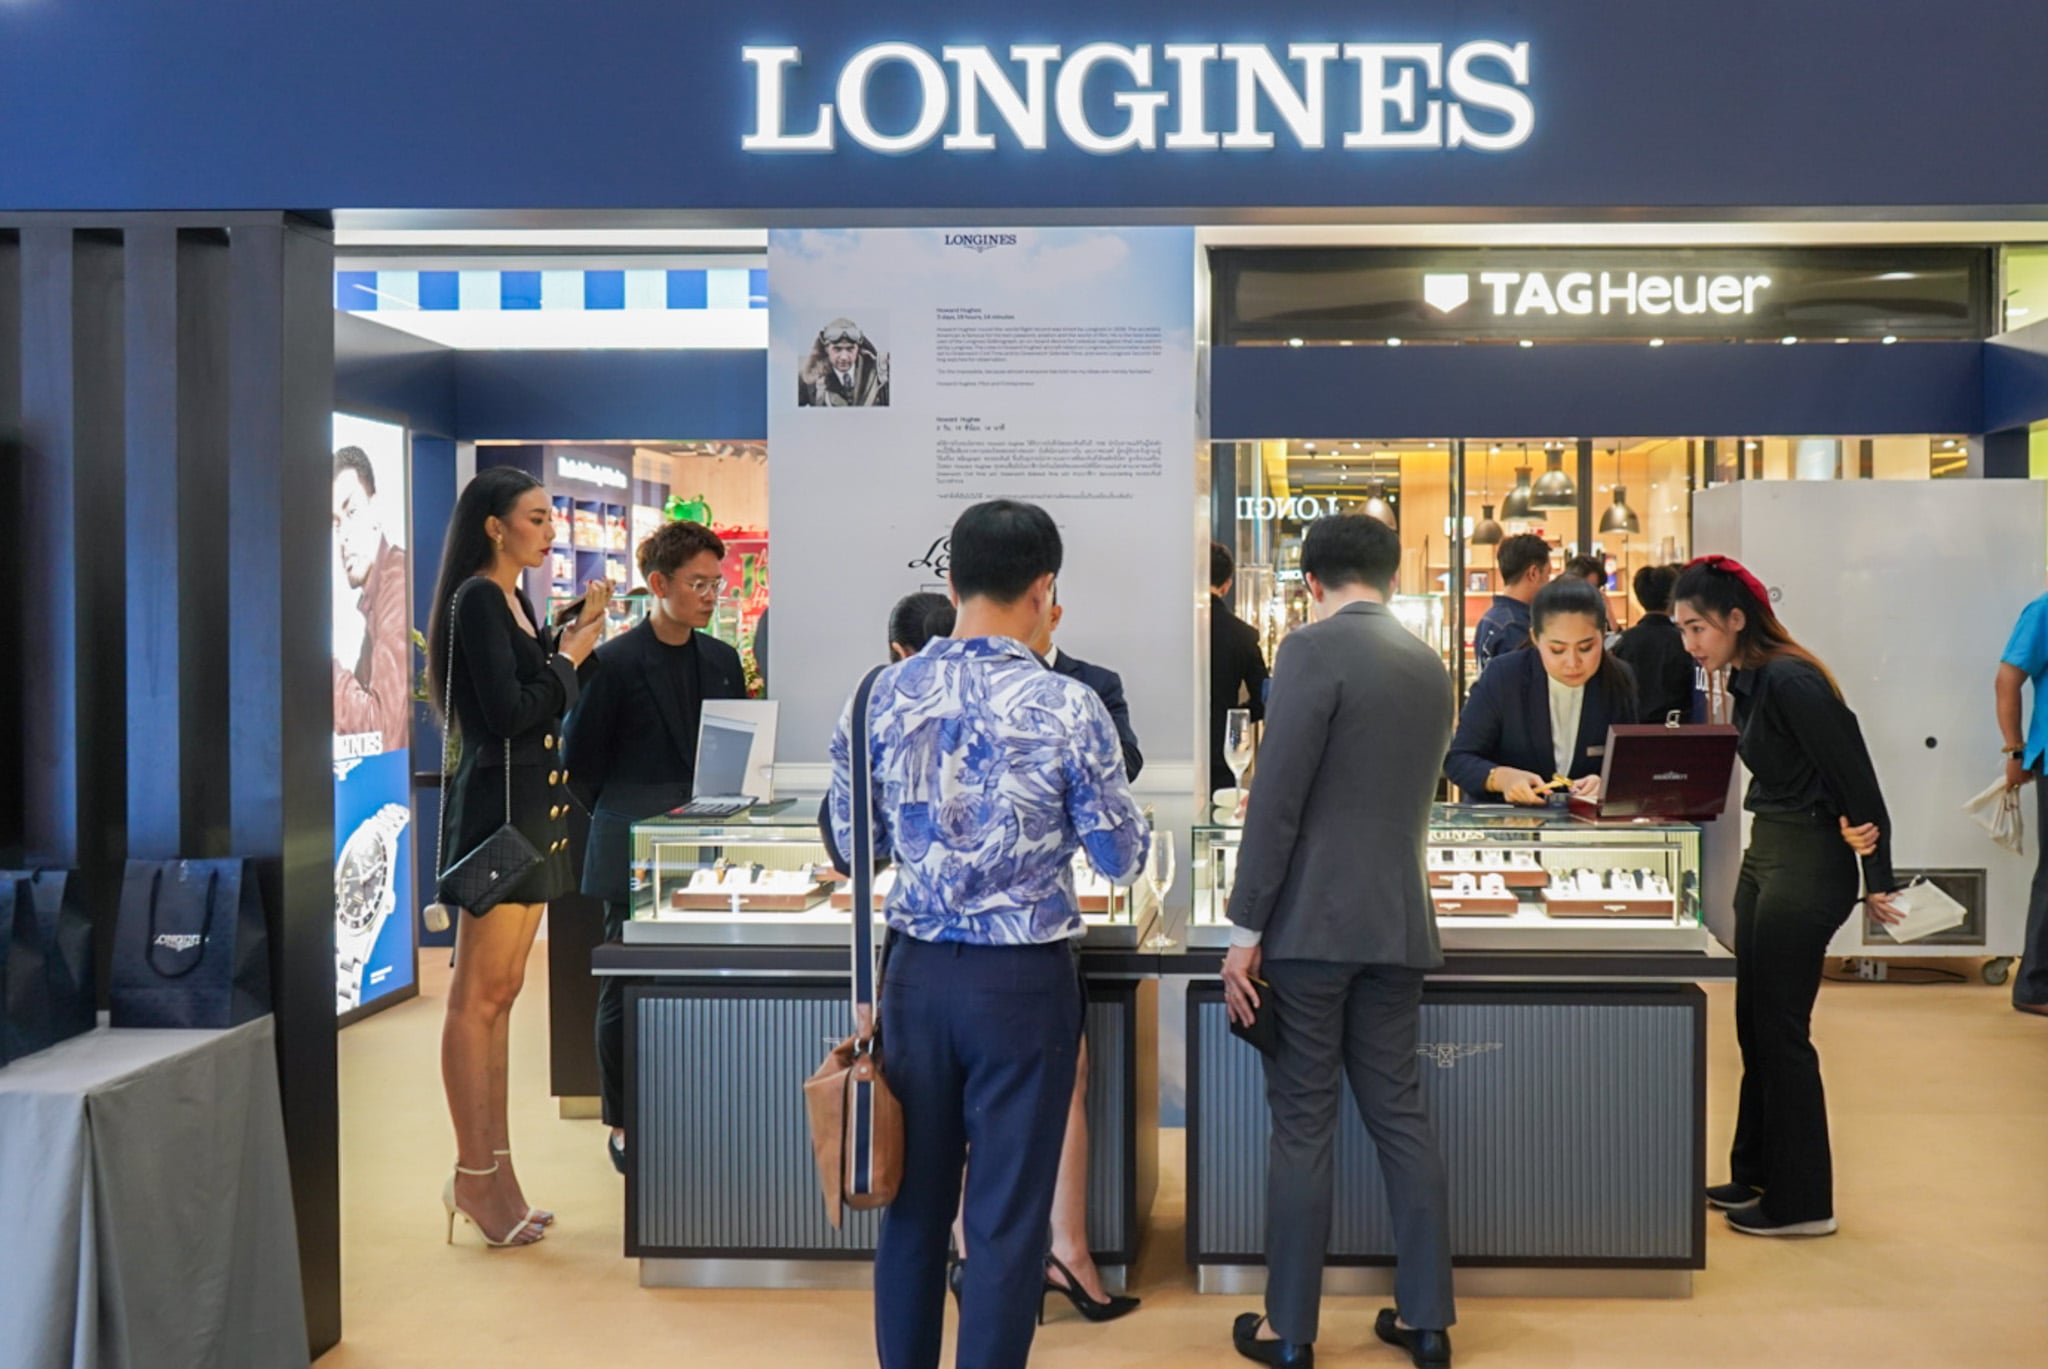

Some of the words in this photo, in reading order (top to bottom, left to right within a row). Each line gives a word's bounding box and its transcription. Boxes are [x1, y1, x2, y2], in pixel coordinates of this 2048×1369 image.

[741, 41, 1535, 152] LONGINES
[944, 233, 1017, 246] LONGINES
[1480, 272, 1593, 314] TAG
[1600, 271, 1772, 315] Heuer
